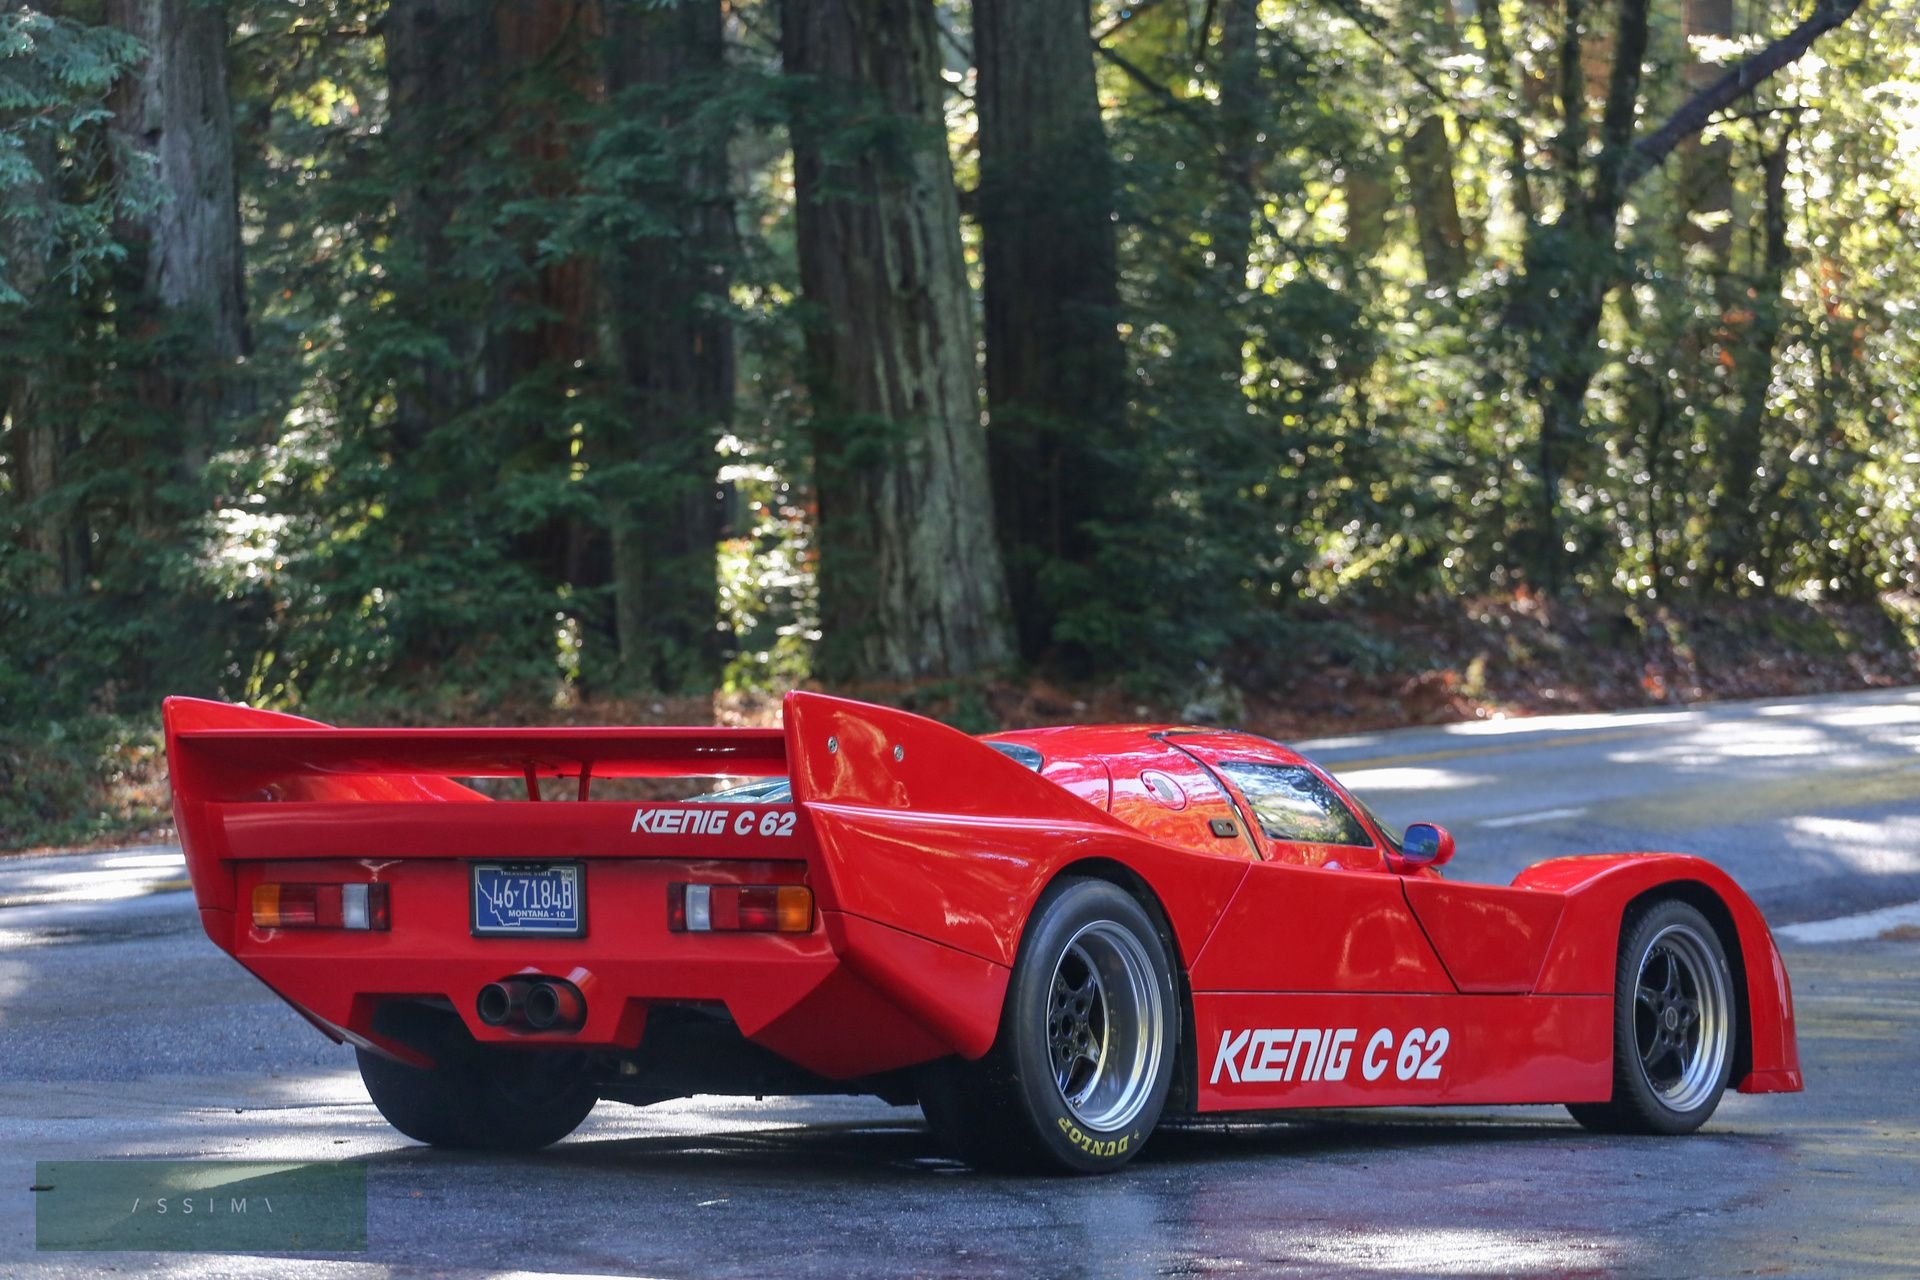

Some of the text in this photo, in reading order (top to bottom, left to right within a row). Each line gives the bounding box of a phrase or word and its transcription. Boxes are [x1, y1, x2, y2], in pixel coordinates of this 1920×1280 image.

[734, 810, 755, 836] C
[759, 811, 797, 836] 62
[1362, 1028, 1393, 1081] C
[1396, 1027, 1450, 1081] 62
[1057, 1117, 1129, 1156] DUNLOP
